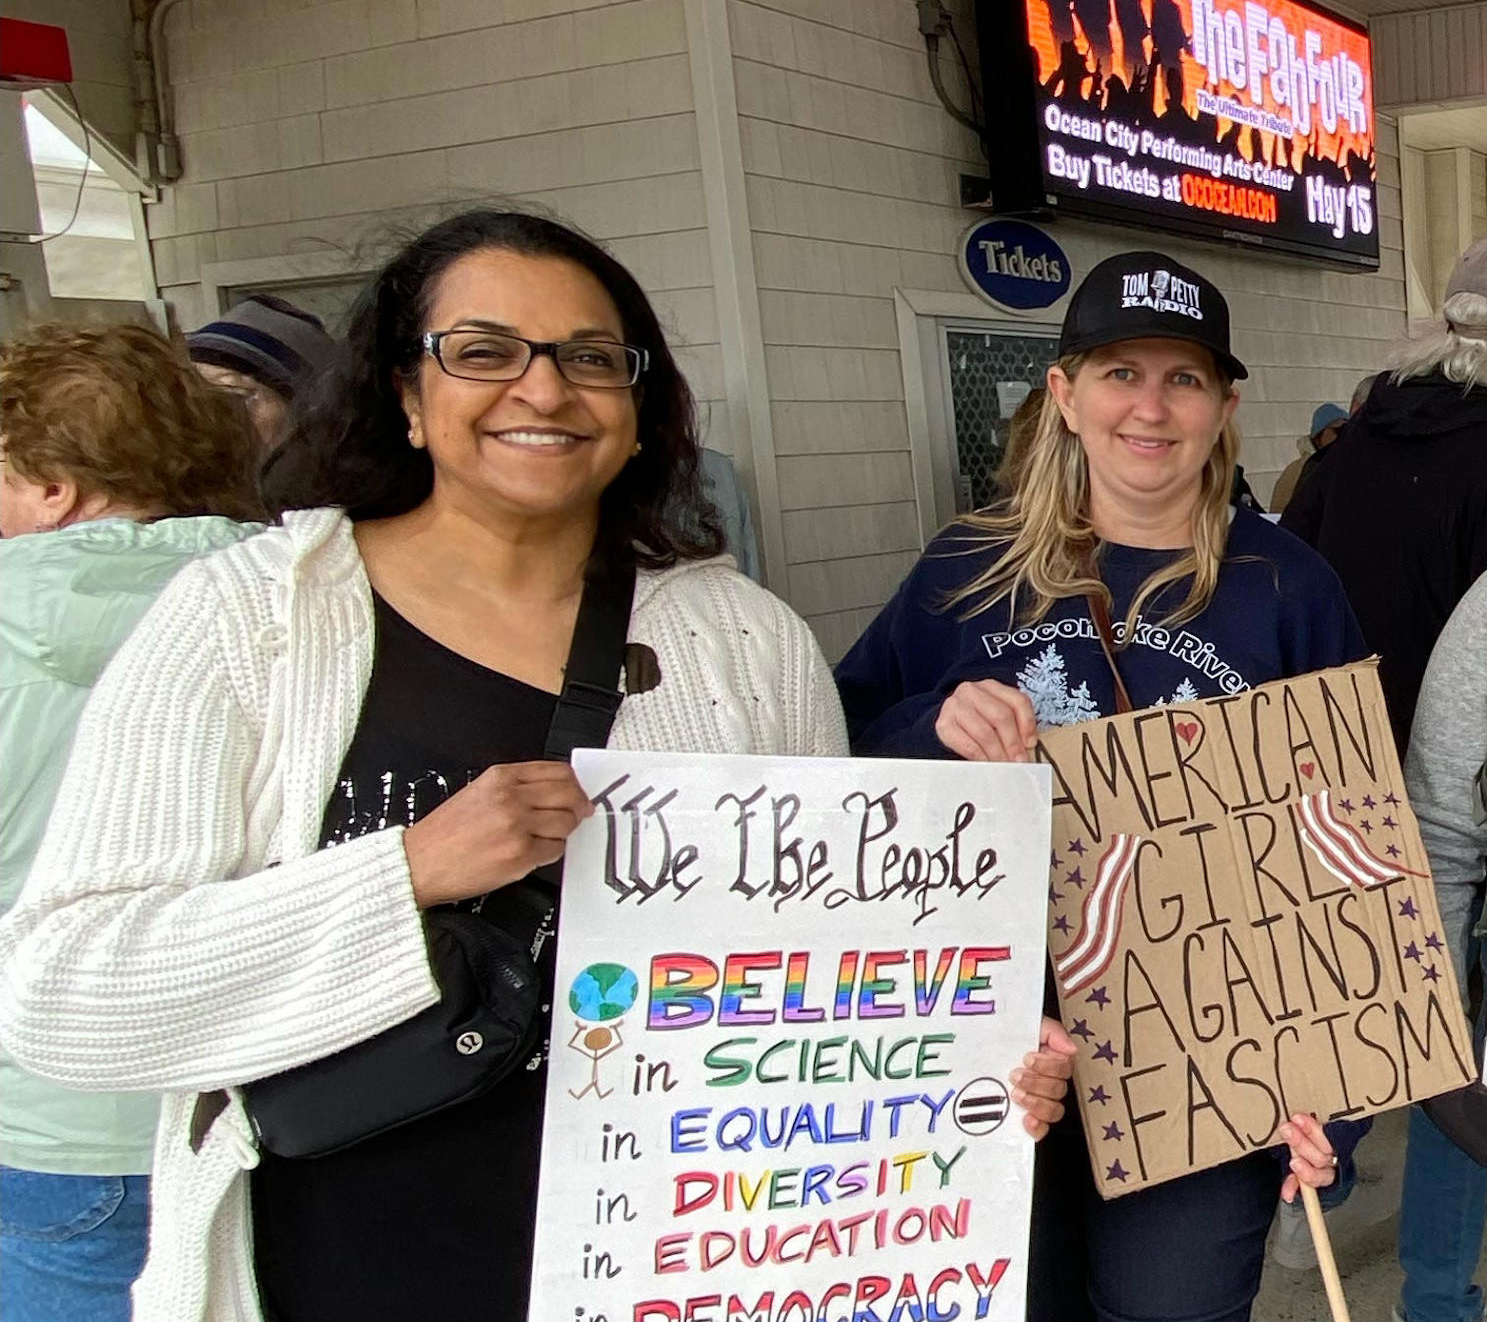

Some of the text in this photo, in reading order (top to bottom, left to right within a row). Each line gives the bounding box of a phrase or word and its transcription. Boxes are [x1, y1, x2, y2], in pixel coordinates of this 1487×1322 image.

[1044, 103, 1295, 191] Ocean City Performing Arts Center
[1048, 143, 1092, 189] Buy
[1092, 154, 1161, 198] Tickets
[1162, 174, 1182, 202] at
[1306, 175, 1373, 239] May 15
[979, 240, 1063, 284] Tickets
[1122, 272, 1200, 308] TOM PETTY
[1121, 296, 1203, 320] RADIO
[1034, 673, 1377, 844] AMERICAN
[587, 773, 702, 905] We
[716, 784, 835, 912] The
[824, 787, 1006, 925] People
[1132, 804, 1351, 944] GIRL
[645, 947, 1011, 1030] BELIEVE
[1124, 876, 1408, 1067] AGAINST
[633, 1033, 956, 1095] in SCIENCE
[1121, 990, 1470, 1181] FASCISM
[602, 1089, 956, 1162] in EQUALITY
[596, 1145, 967, 1225] in DIVERSITY
[583, 1197, 970, 1279] in EDUCATION
